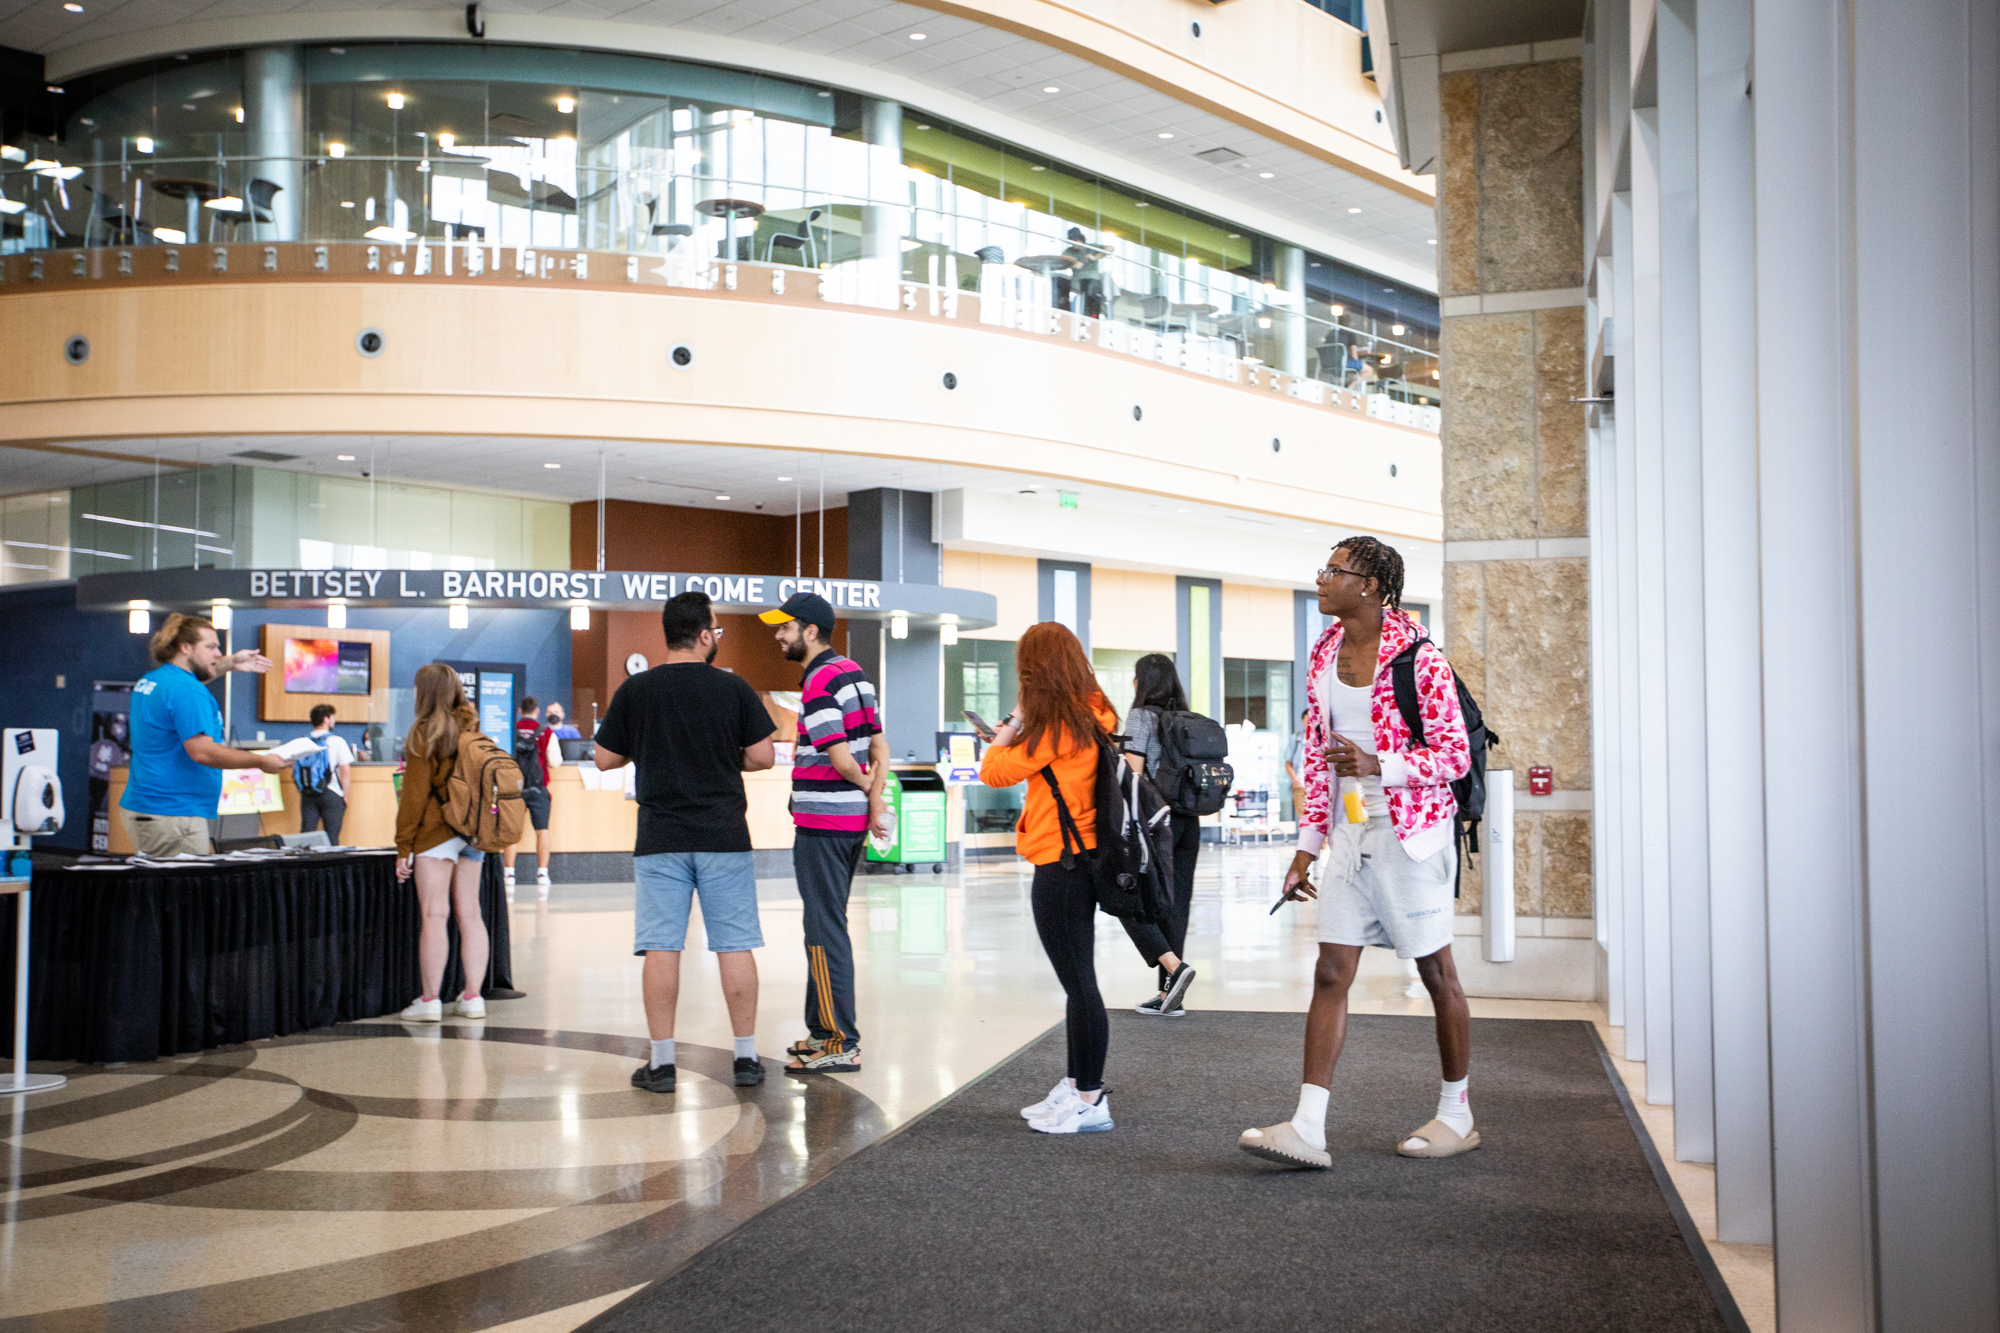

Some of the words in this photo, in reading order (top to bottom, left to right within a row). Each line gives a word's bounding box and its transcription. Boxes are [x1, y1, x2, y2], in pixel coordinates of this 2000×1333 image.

[250, 570, 382, 597] BETTSEY
[400, 570, 426, 597] L.
[443, 571, 607, 599] BARHORST
[621, 573, 765, 603] WELCOME
[778, 578, 881, 608] CENTER
